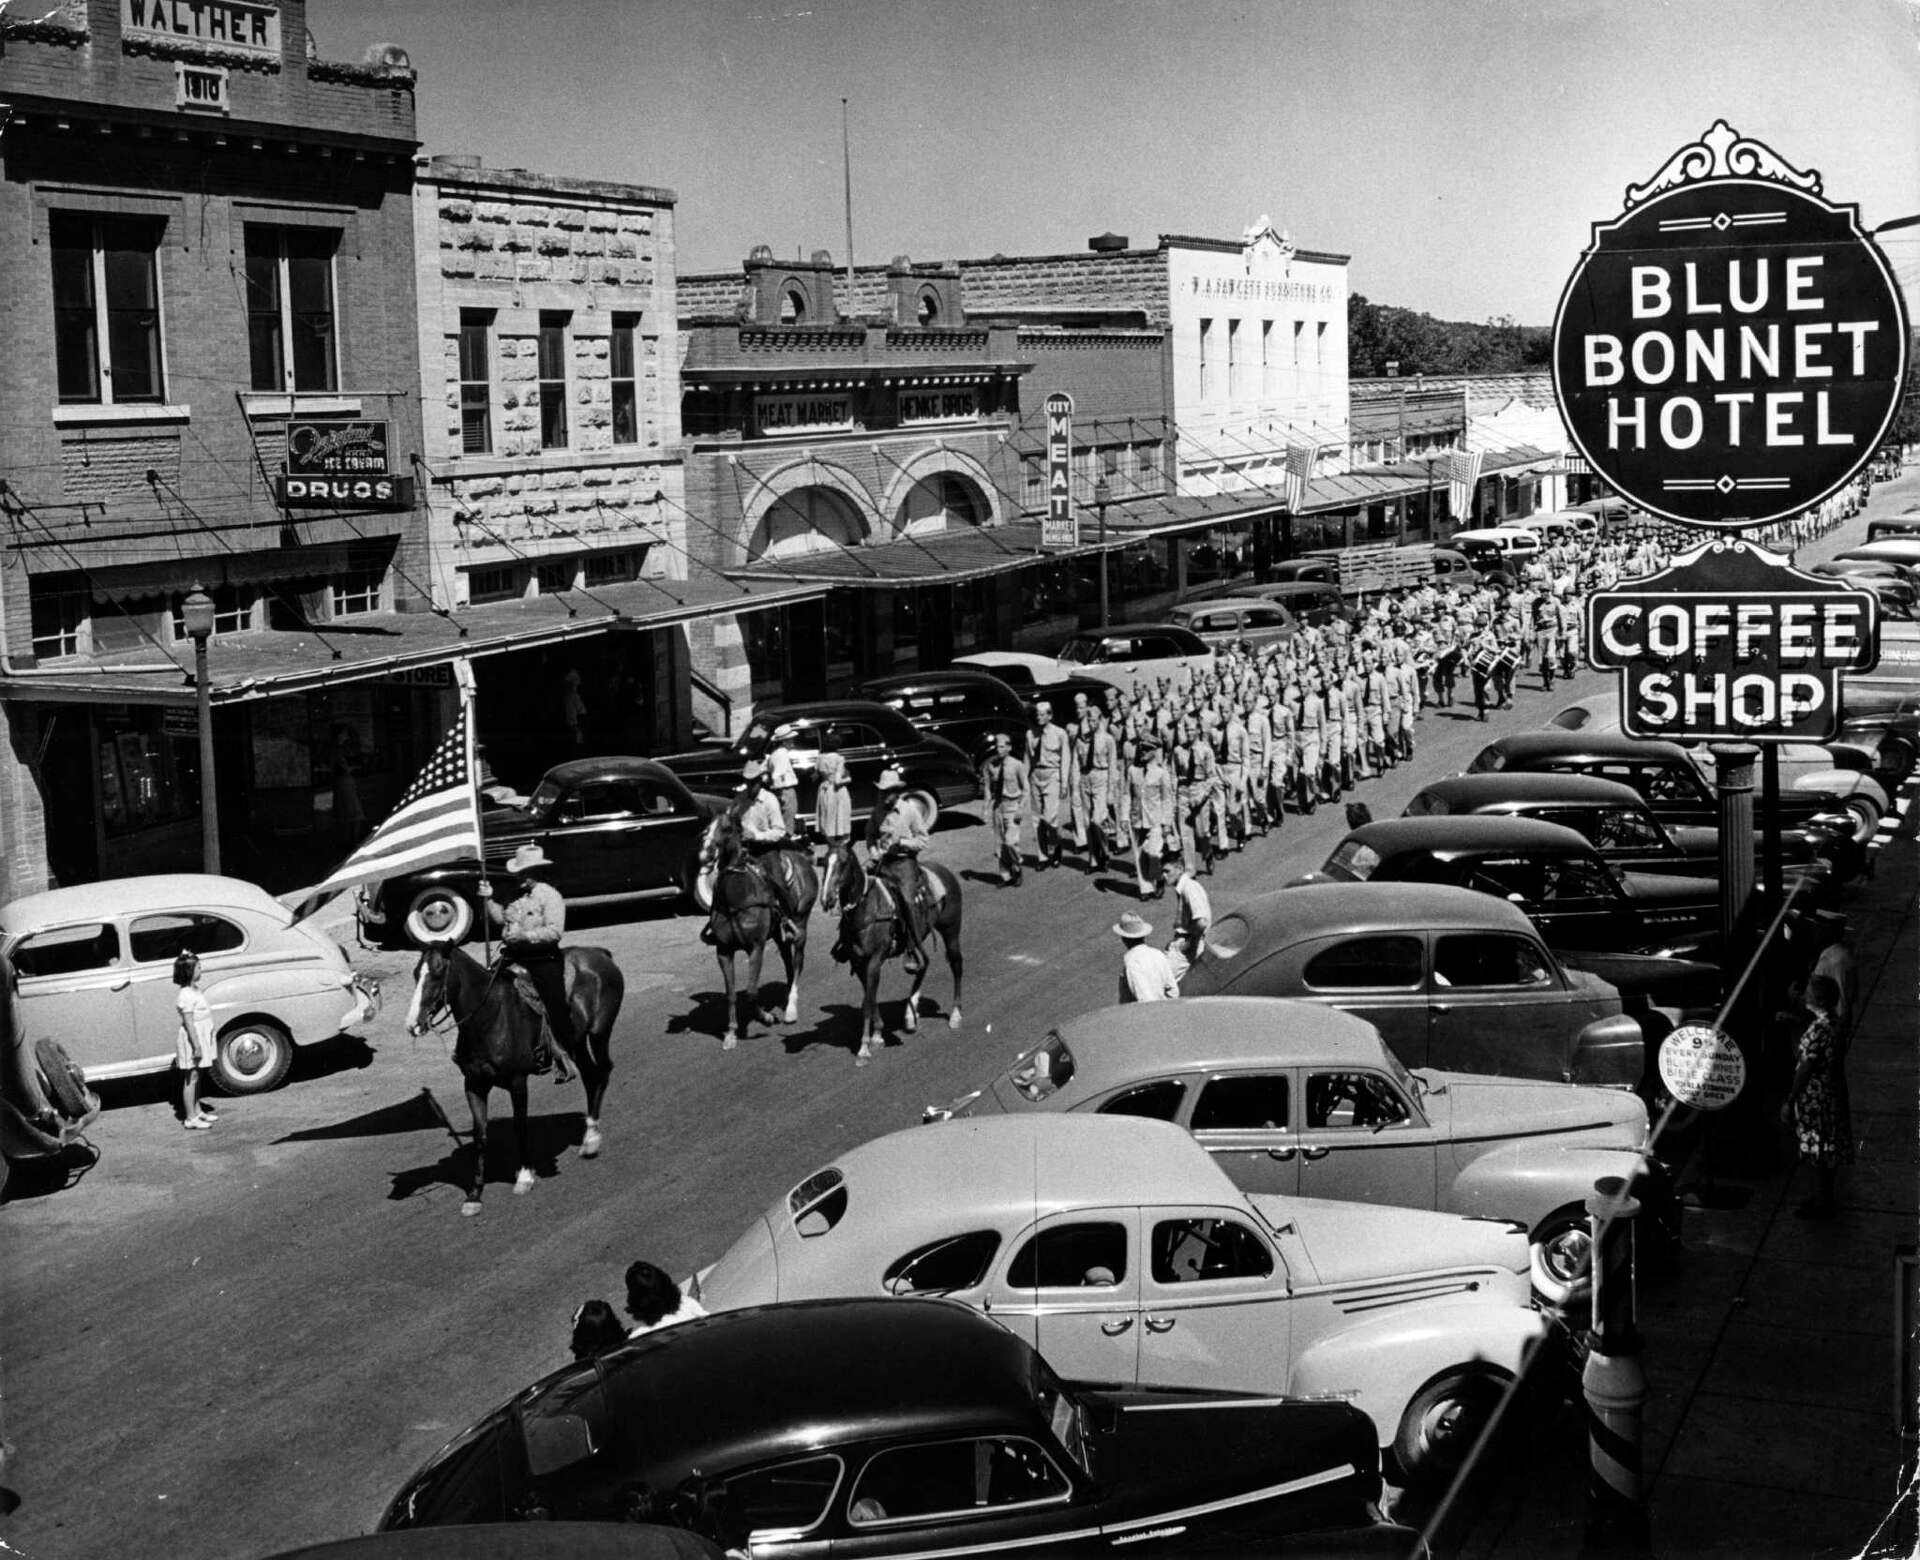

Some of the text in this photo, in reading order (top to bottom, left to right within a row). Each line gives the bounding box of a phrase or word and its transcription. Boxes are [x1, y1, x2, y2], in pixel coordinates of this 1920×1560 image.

[130, 0, 267, 46] WALTHER
[1631, 256, 1825, 319] BLUE
[1584, 321, 1880, 387] BONNET
[757, 400, 848, 427] MEAT MARKET
[1048, 401, 1070, 413] CITY
[1608, 391, 1855, 451] HOTEL
[344, 456, 385, 470] CREAM
[1051, 416, 1068, 515] MEAT
[287, 481, 393, 499] DRUGS
[1601, 604, 1861, 658] COFFEE
[1637, 673, 1825, 727] SHOP
[1665, 1047, 1741, 1062] EVERY SUNDAY
[1702, 1072, 1741, 1086] CLASS
